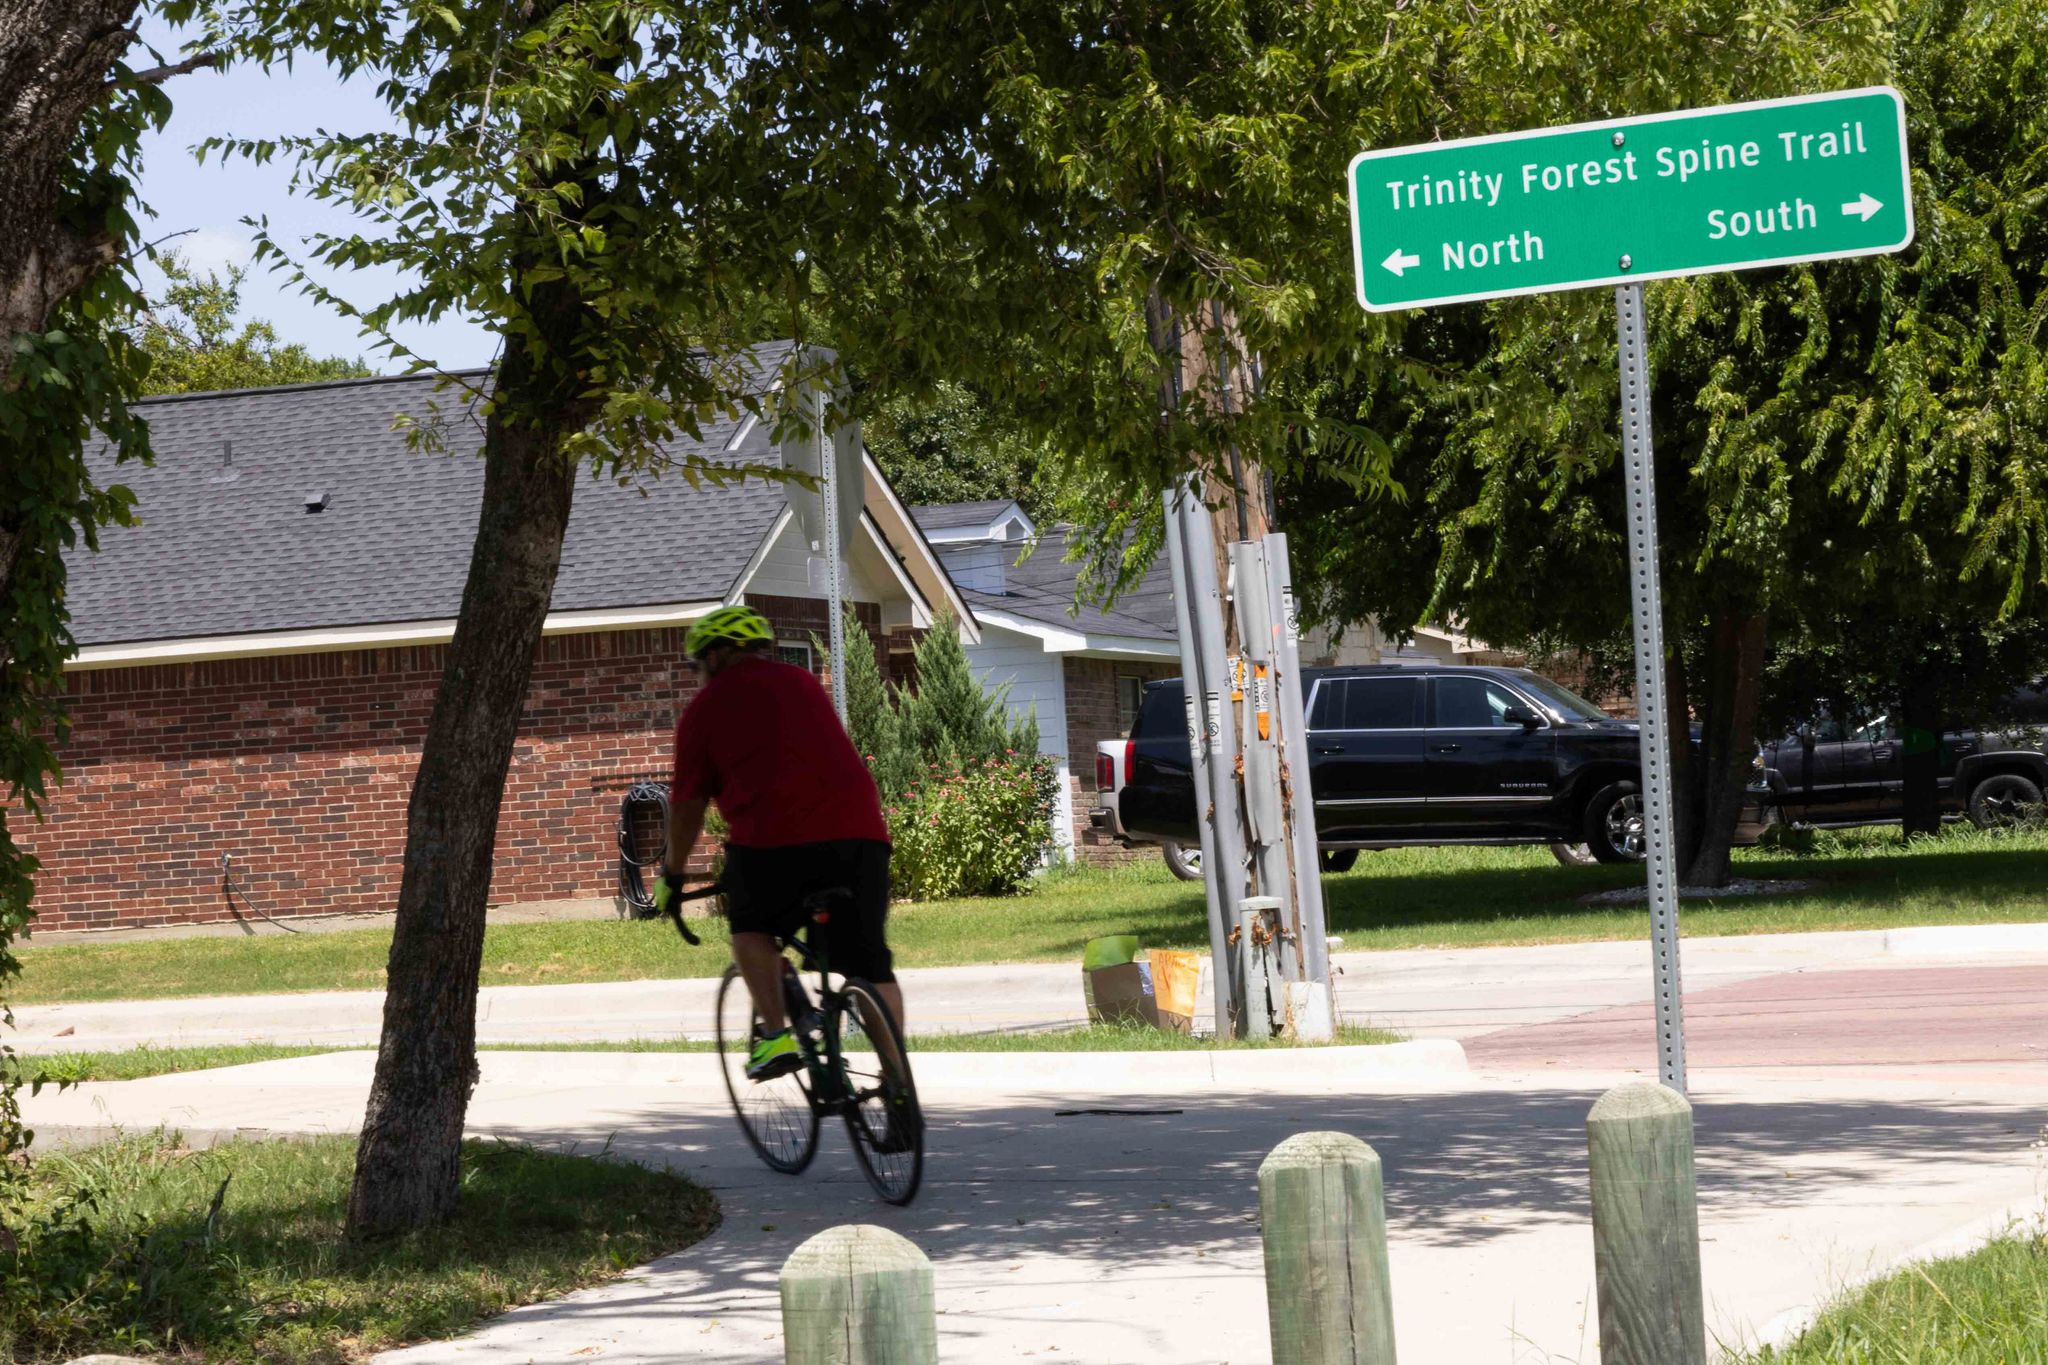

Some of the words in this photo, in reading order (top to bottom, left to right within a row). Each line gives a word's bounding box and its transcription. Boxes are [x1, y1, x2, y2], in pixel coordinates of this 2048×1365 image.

[1386, 171, 1504, 210] Trinity
[1522, 151, 1638, 194] Forest
[1656, 140, 1760, 183] Spine
[1778, 121, 1868, 162] Trail
[1707, 197, 1817, 240] South
[1442, 230, 1545, 271] North
